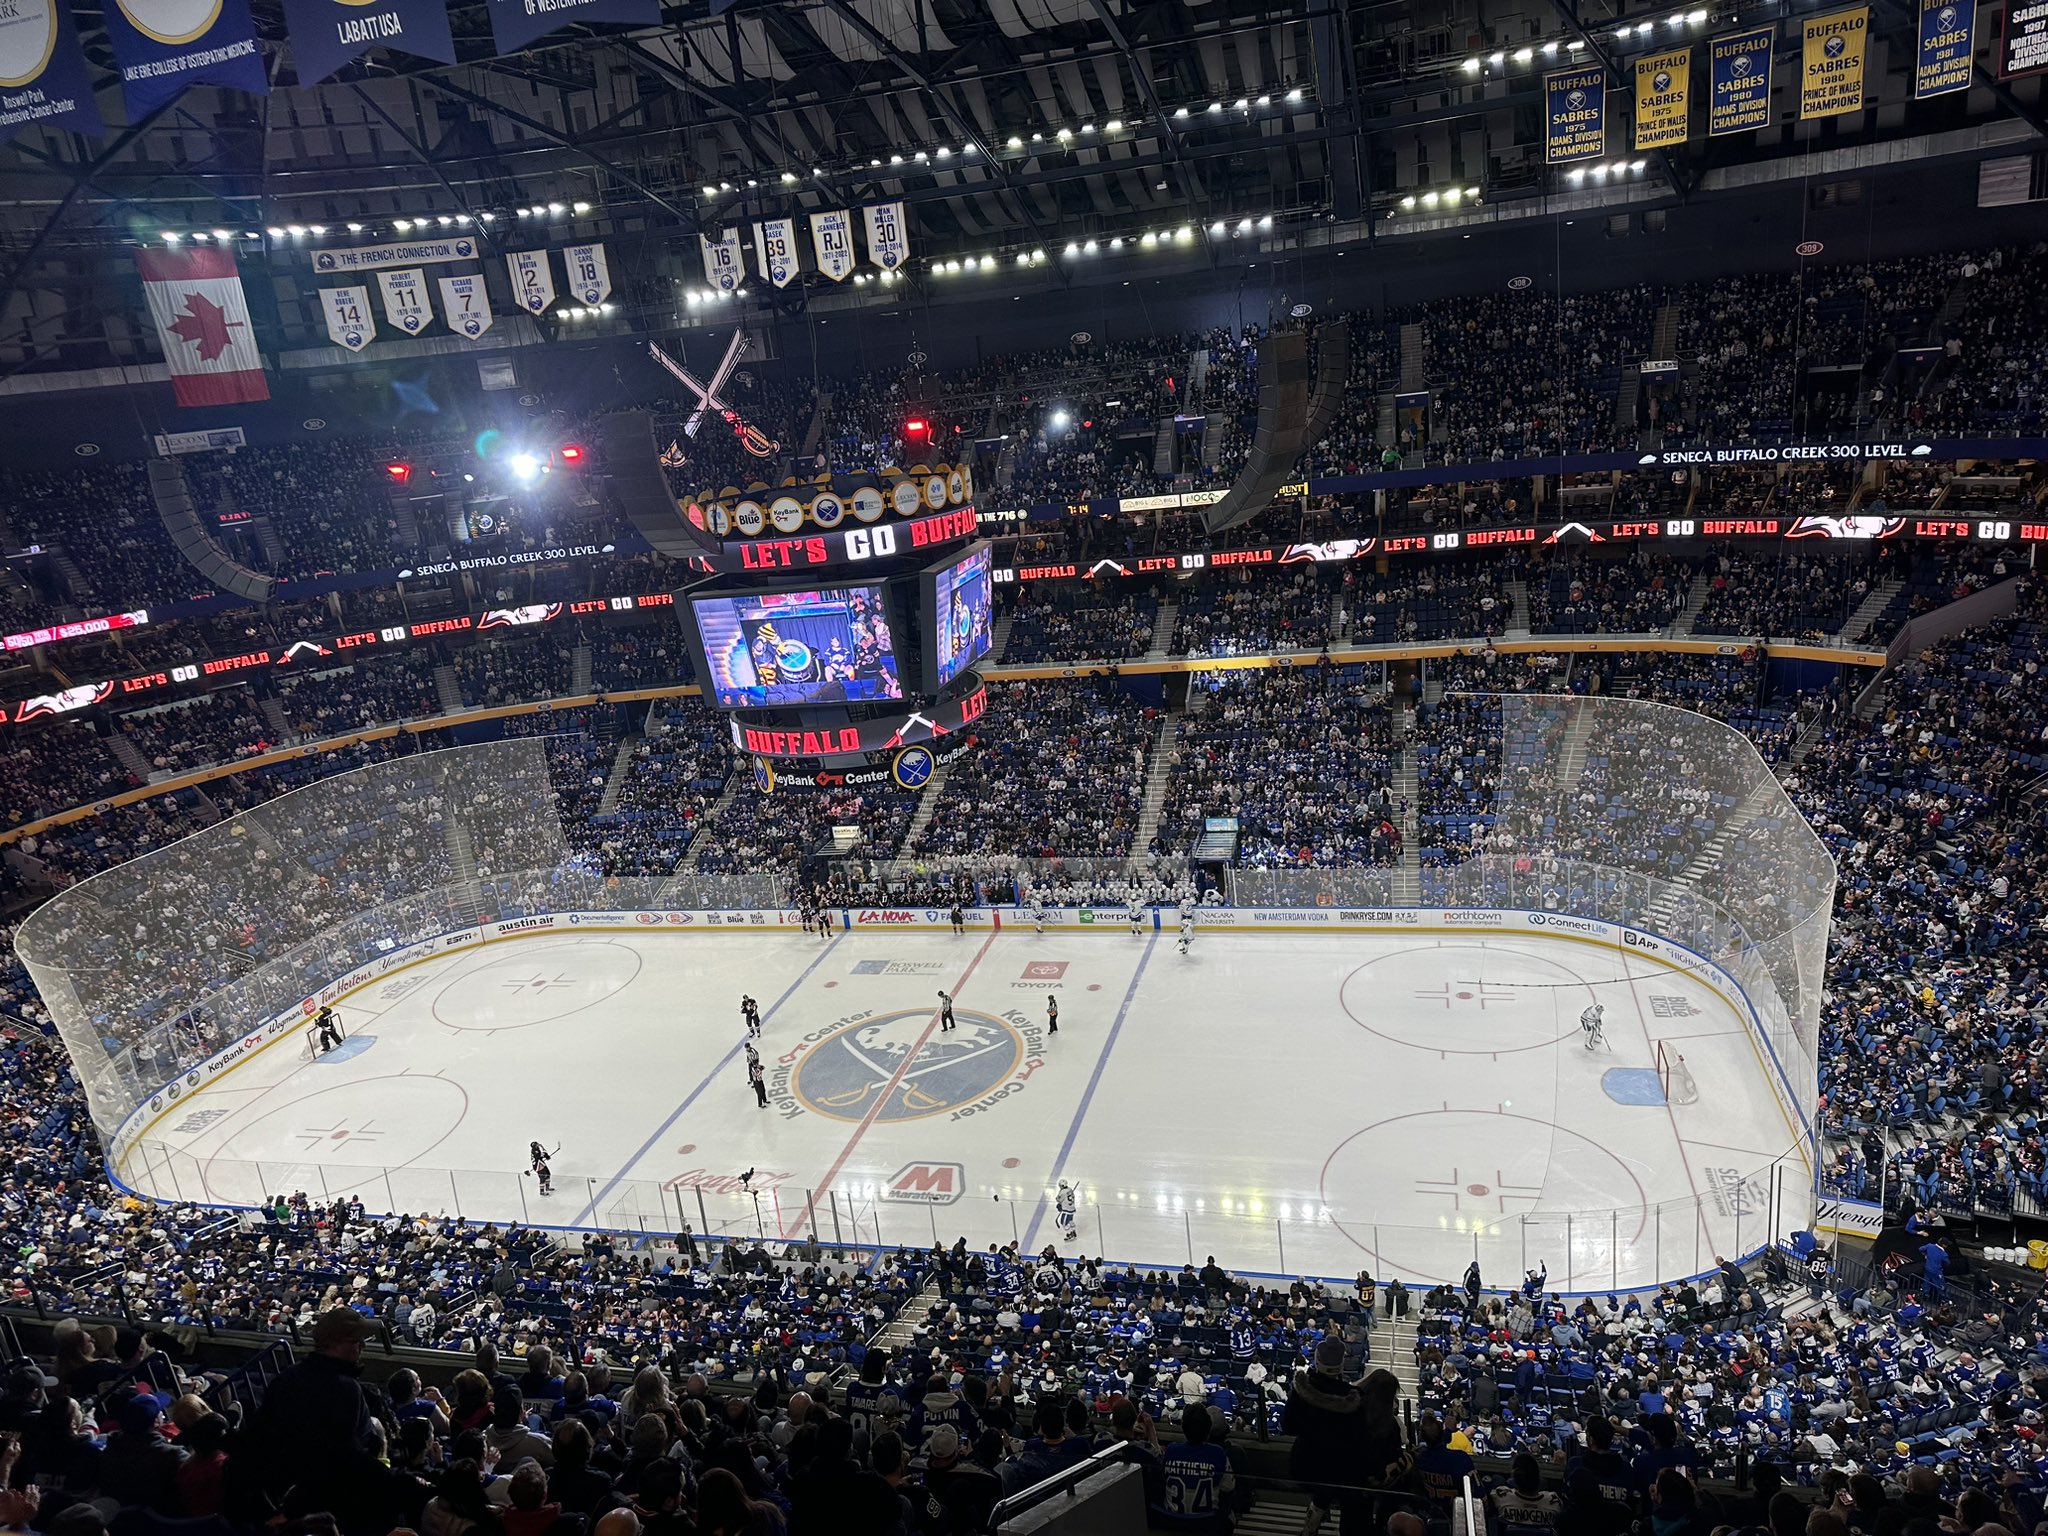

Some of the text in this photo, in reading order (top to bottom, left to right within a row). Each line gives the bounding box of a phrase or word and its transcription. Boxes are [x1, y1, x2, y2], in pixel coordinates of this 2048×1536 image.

[524, 1, 538, 15] OF
[337, 11, 403, 44] LABATT USA
[1807, 18, 1864, 39] BUFFALO
[2023, 21, 2046, 34] 1997
[1716, 39, 1768, 58] BUFFALO
[1924, 29, 1968, 51] SABRES
[123, 39, 256, 81] LAKE ERIE COLLEGE OF OSTEOPATHIC MEDICINE
[1936, 48, 1954, 60] 1981
[1638, 55, 1686, 74] BUFFALO
[1809, 55, 1859, 76] SABRES
[1919, 55, 1970, 76] ADAMS DIVISION
[1550, 73, 1601, 92] BUFFALO
[1718, 74, 1765, 93] SABRES
[1820, 73, 1845, 85] 1980
[1919, 70, 1968, 91] CHAMPIONS
[4, 88, 45, 109] Roswell Park
[1729, 91, 1752, 102] 1980
[1803, 81, 1861, 100] PRINCE OF WALES
[29, 99, 76, 118] Cancer Center
[1641, 91, 1684, 109] SABRES
[1713, 98, 1767, 117] ADAMS DIVISION
[1803, 94, 1860, 113] CHAMPIONS
[1552, 108, 1598, 125] SABRES
[1651, 106, 1672, 117] 1975
[1713, 110, 1766, 128] CHAMPIONS
[1565, 123, 1586, 132] 1975
[1637, 113, 1686, 132] PRINCE OF WALES
[1550, 129, 1602, 147] ADAMS DIVISION
[1637, 127, 1686, 143] CHAMPIONS
[1550, 141, 1601, 158] CHAMPIONS
[824, 216, 837, 224] RICK
[874, 214, 895, 223] MILLER
[824, 232, 843, 251] RJ
[877, 223, 896, 243] 30
[340, 245, 451, 265] THE FRENCH CONNECTION
[714, 248, 730, 266] 16
[767, 239, 785, 257] 39
[1802, 244, 1817, 253] 309
[525, 269, 537, 287] 2
[579, 263, 596, 281] 18
[1514, 278, 1526, 287] 308
[395, 288, 417, 307] 11
[459, 294, 472, 312] 7
[336, 305, 361, 324] 14
[1663, 444, 1907, 464] SENECA BUFFALO CREEK 300 LEVEL
[774, 508, 799, 517] KeyBank
[984, 510, 1016, 522] THE 716
[1067, 504, 1088, 515] 7:14
[739, 514, 760, 525] Blue
[1613, 520, 1778, 537] LET'S GO BUFFALO
[1916, 521, 2010, 539] LET'S GO
[740, 524, 896, 569] LET'S GO
[1384, 528, 1535, 552] LET'S GO BUFFALO
[417, 545, 599, 576] SENECA BUFFALO CREEK 300 LEVEL
[1138, 550, 1272, 571] LET'S GO BUFFALO
[993, 565, 1076, 583] GO BUFFALO
[569, 597, 633, 614] LET'S GO
[59, 620, 110, 638] $25,000
[336, 617, 472, 649] LET'S GO BUFFALO
[122, 651, 270, 692] LET'S GO BUFFALO
[745, 727, 860, 755] BUFFALO
[936, 742, 970, 765] KeyBank
[773, 769, 890, 787] KeyBank Center
[498, 916, 555, 932] austin air
[727, 914, 744, 923] Blue
[858, 910, 915, 923] LA NOVA
[1200, 911, 1235, 919] NIAGARA
[1254, 912, 1329, 921] NEW AMSTERDAM VODKA
[1340, 911, 1393, 921] DRINKRYSE.COM
[1444, 911, 1502, 920] northtown
[1547, 916, 1608, 935] ConnectLife
[378, 948, 422, 972] Yuengling
[319, 986, 337, 1005] Tim
[337, 971, 373, 995] Hortons
[266, 1009, 304, 1035] Wegmans
[804, 1009, 874, 1043] Center
[1001, 1009, 1047, 1061] KeyBank
[208, 1046, 245, 1073] KeyBank
[768, 1062, 805, 1120] KeyBank
[950, 1082, 1025, 1122] Center
[888, 1190, 951, 1201] Marathon
[1718, 1168, 1753, 1217] SENECA
[1812, 1260, 1828, 1273] 89
[418, 1315, 432, 1327] 20
[1238, 1333, 1251, 1348] 13
[1770, 1395, 1783, 1410] 15
[923, 1409, 959, 1423] POTVIN
[1164, 1461, 1215, 1476] MATTHEWS
[1166, 1476, 1214, 1514] 34
